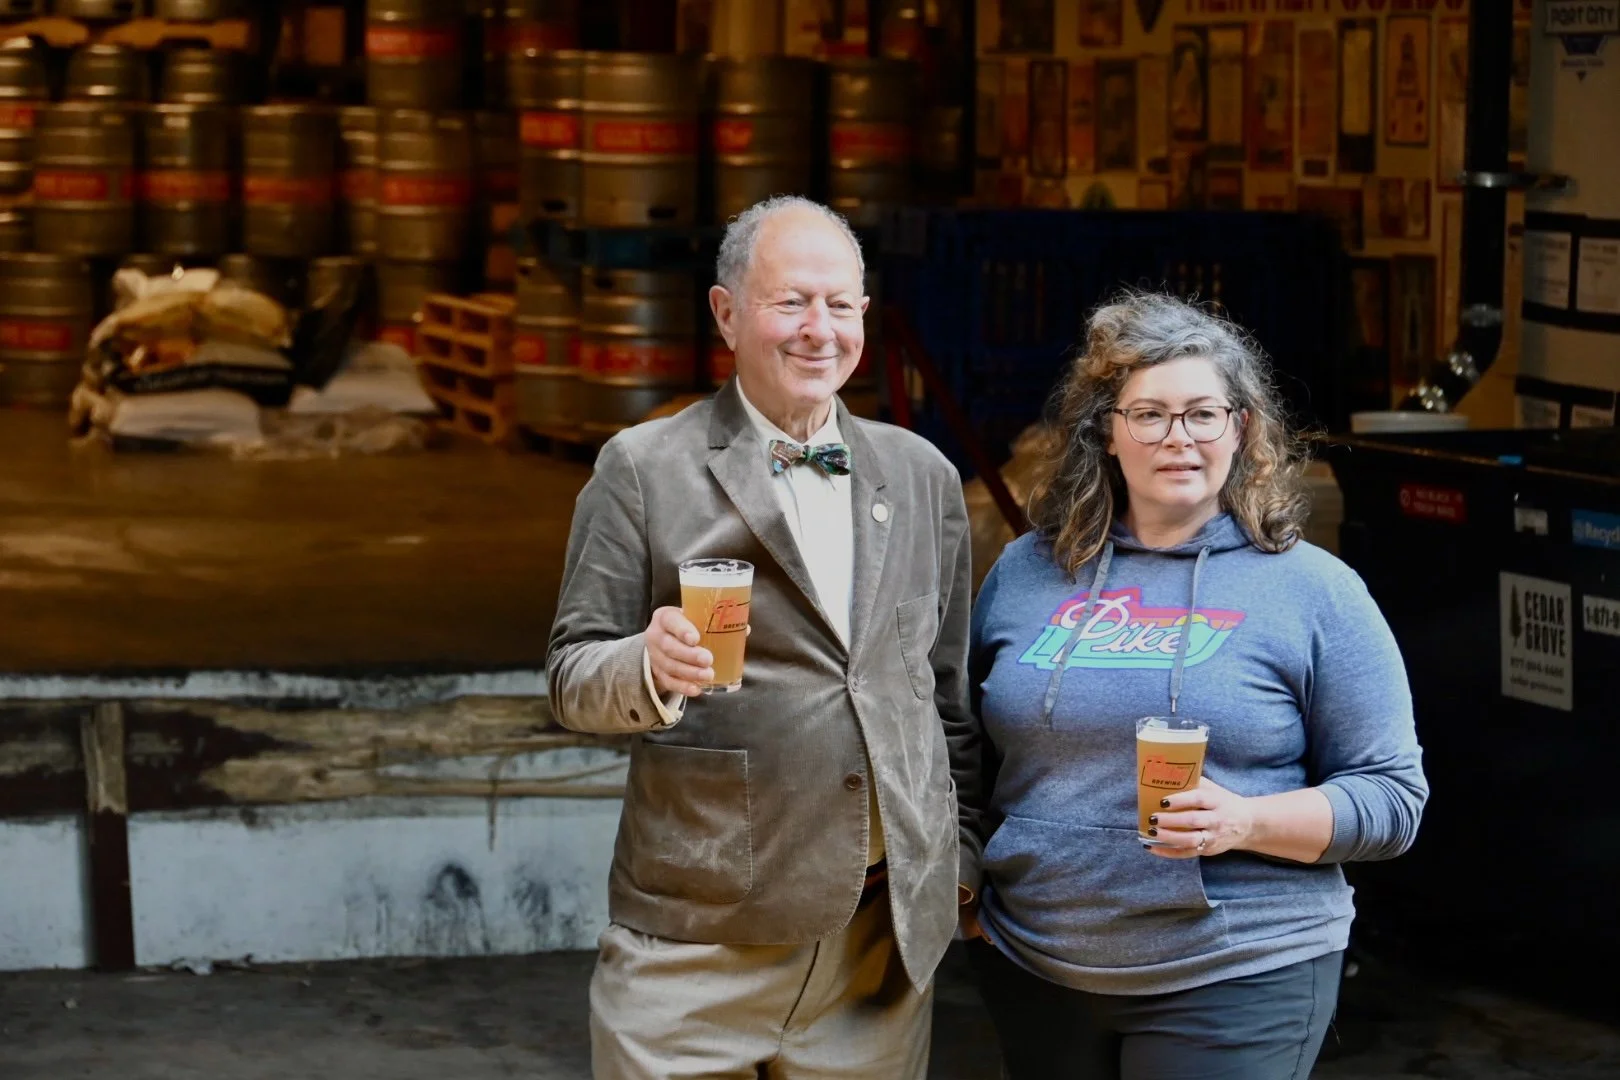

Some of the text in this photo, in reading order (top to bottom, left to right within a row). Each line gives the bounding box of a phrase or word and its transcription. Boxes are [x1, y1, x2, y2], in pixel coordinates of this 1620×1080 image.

[1586, 5, 1615, 24] CITY
[1524, 591, 1565, 625] CEDAR
[1050, 595, 1185, 663] Pike
[1524, 621, 1566, 657] GROVE
